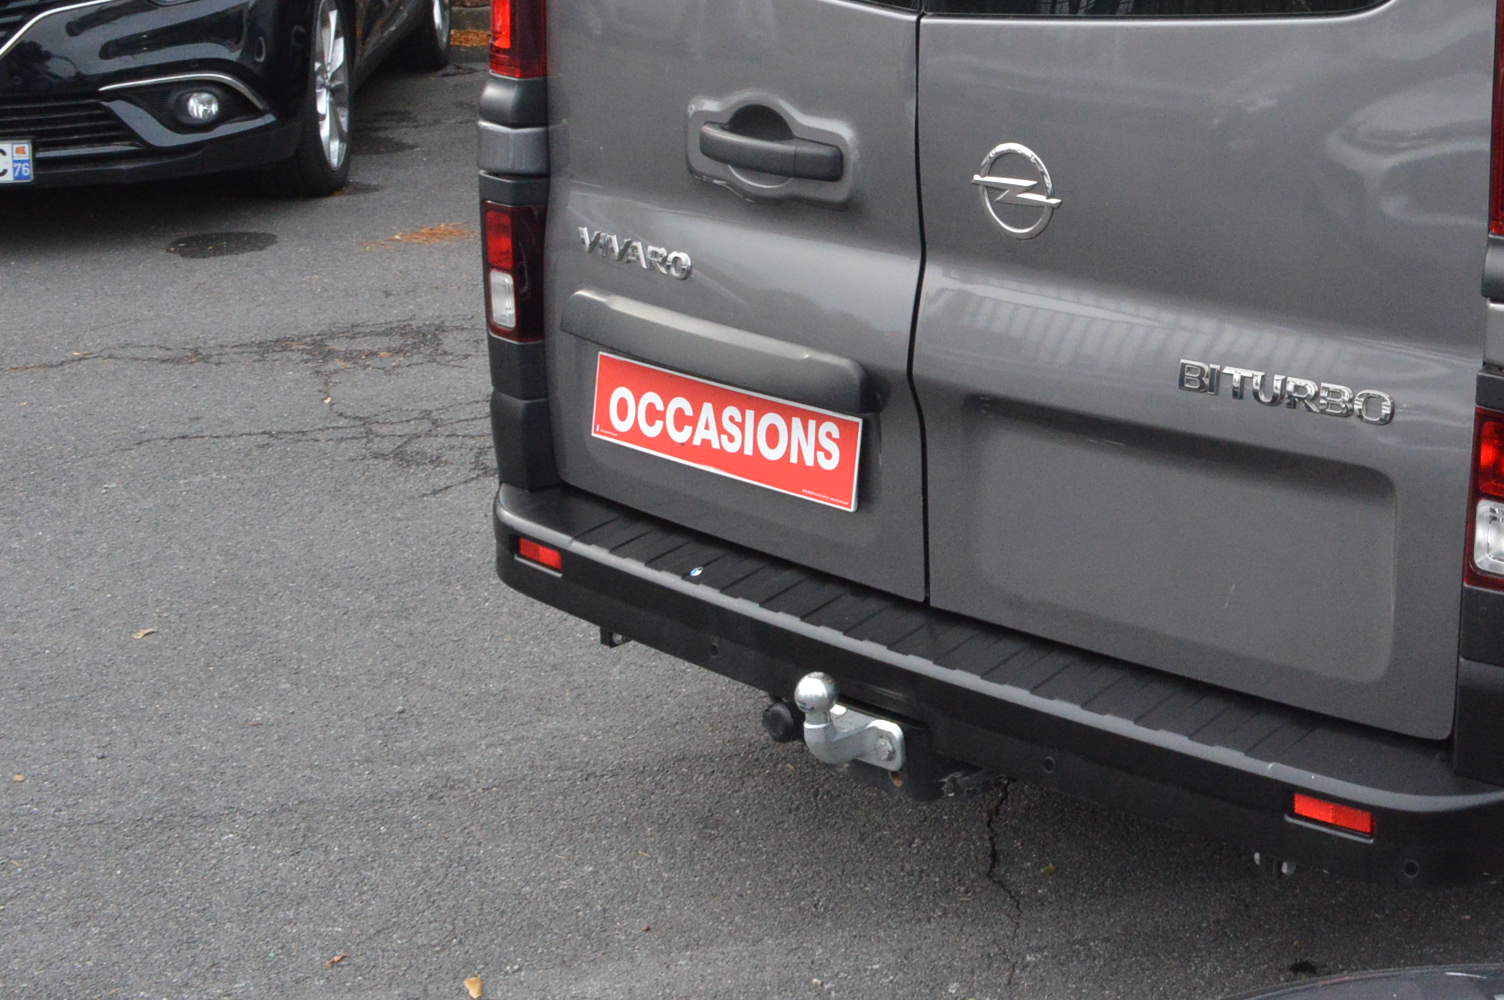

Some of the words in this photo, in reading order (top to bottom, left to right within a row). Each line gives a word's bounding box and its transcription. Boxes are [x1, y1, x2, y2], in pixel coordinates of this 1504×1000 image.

[14, 162, 31, 177] 76
[578, 226, 693, 281] VIVARO
[608, 386, 841, 471] OCCASIONS
